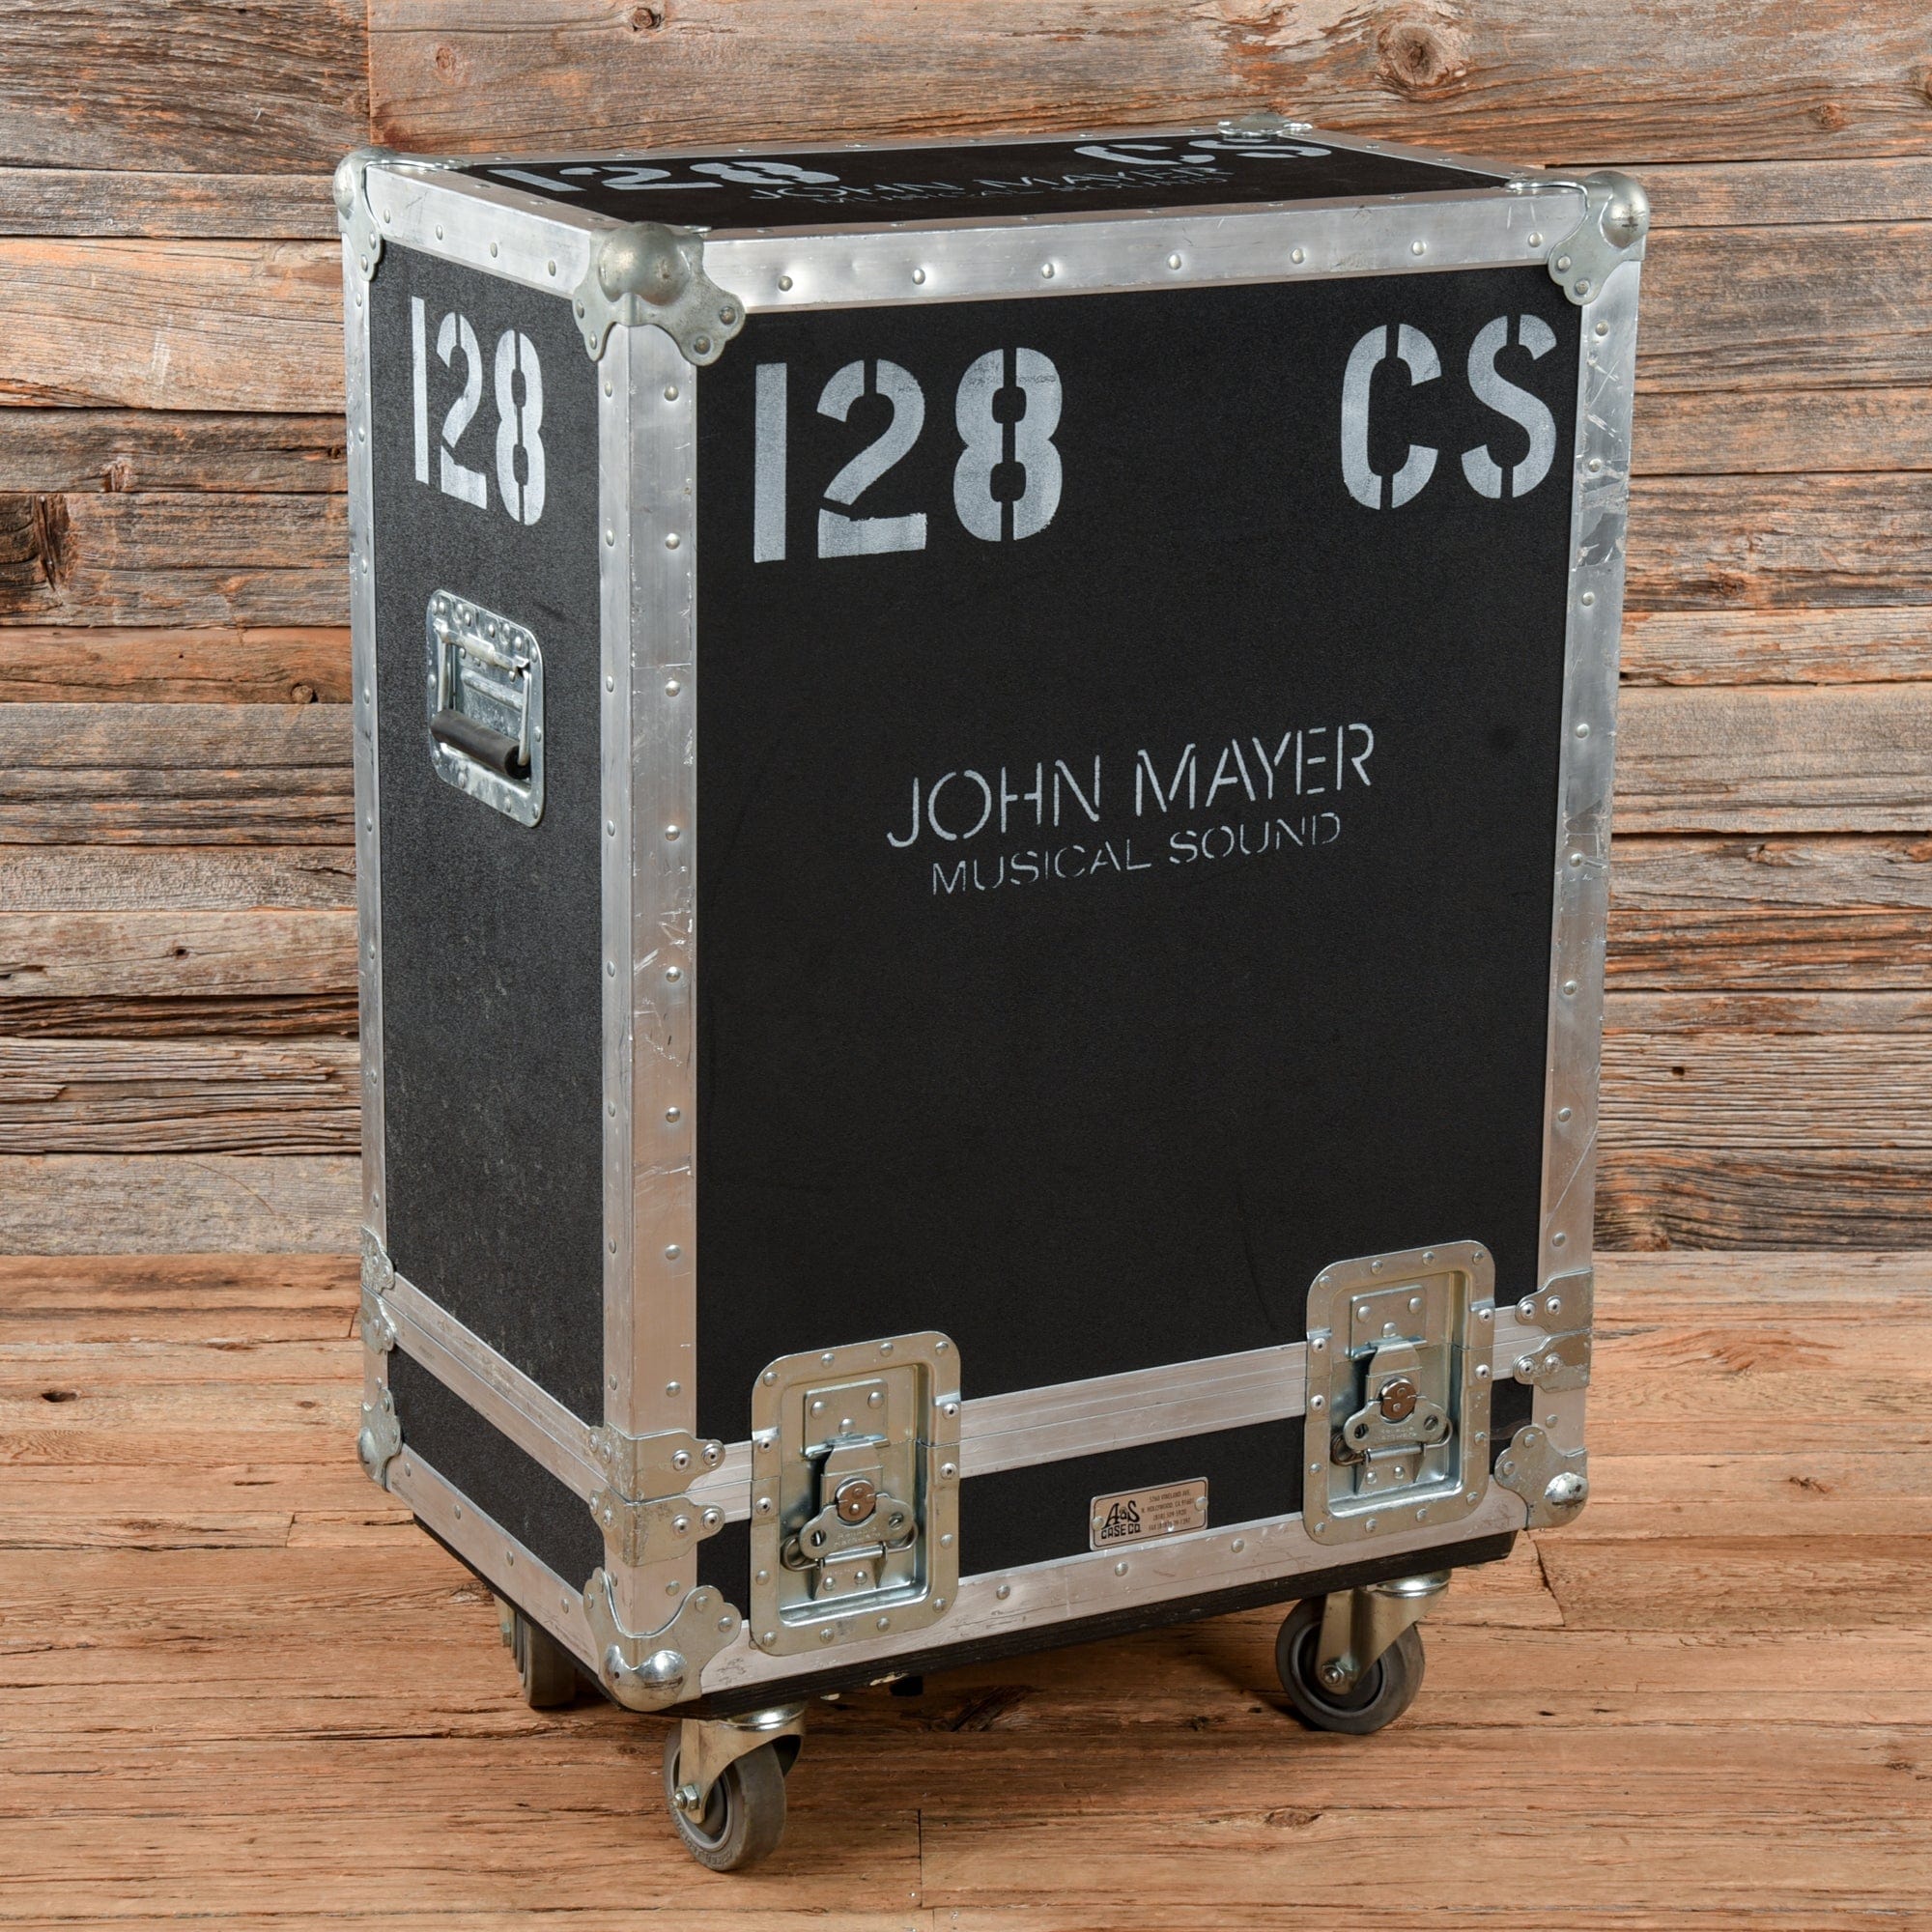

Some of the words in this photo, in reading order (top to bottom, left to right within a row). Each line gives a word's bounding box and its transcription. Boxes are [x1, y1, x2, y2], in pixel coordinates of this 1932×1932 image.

[488, 161, 839, 192] 128
[750, 182, 964, 200] JOHN
[974, 167, 1234, 188] MAYER
[1074, 138, 1332, 165] CS
[412, 296, 547, 526] 128
[1340, 314, 1558, 510] CS
[753, 347, 1063, 563] 128
[887, 754, 1100, 847] JOHN
[1136, 723, 1376, 817] MAYER
[932, 838, 1152, 895] MUSICAL
[1169, 811, 1342, 865] SOUND
[1101, 1523, 1127, 1539] CASE
